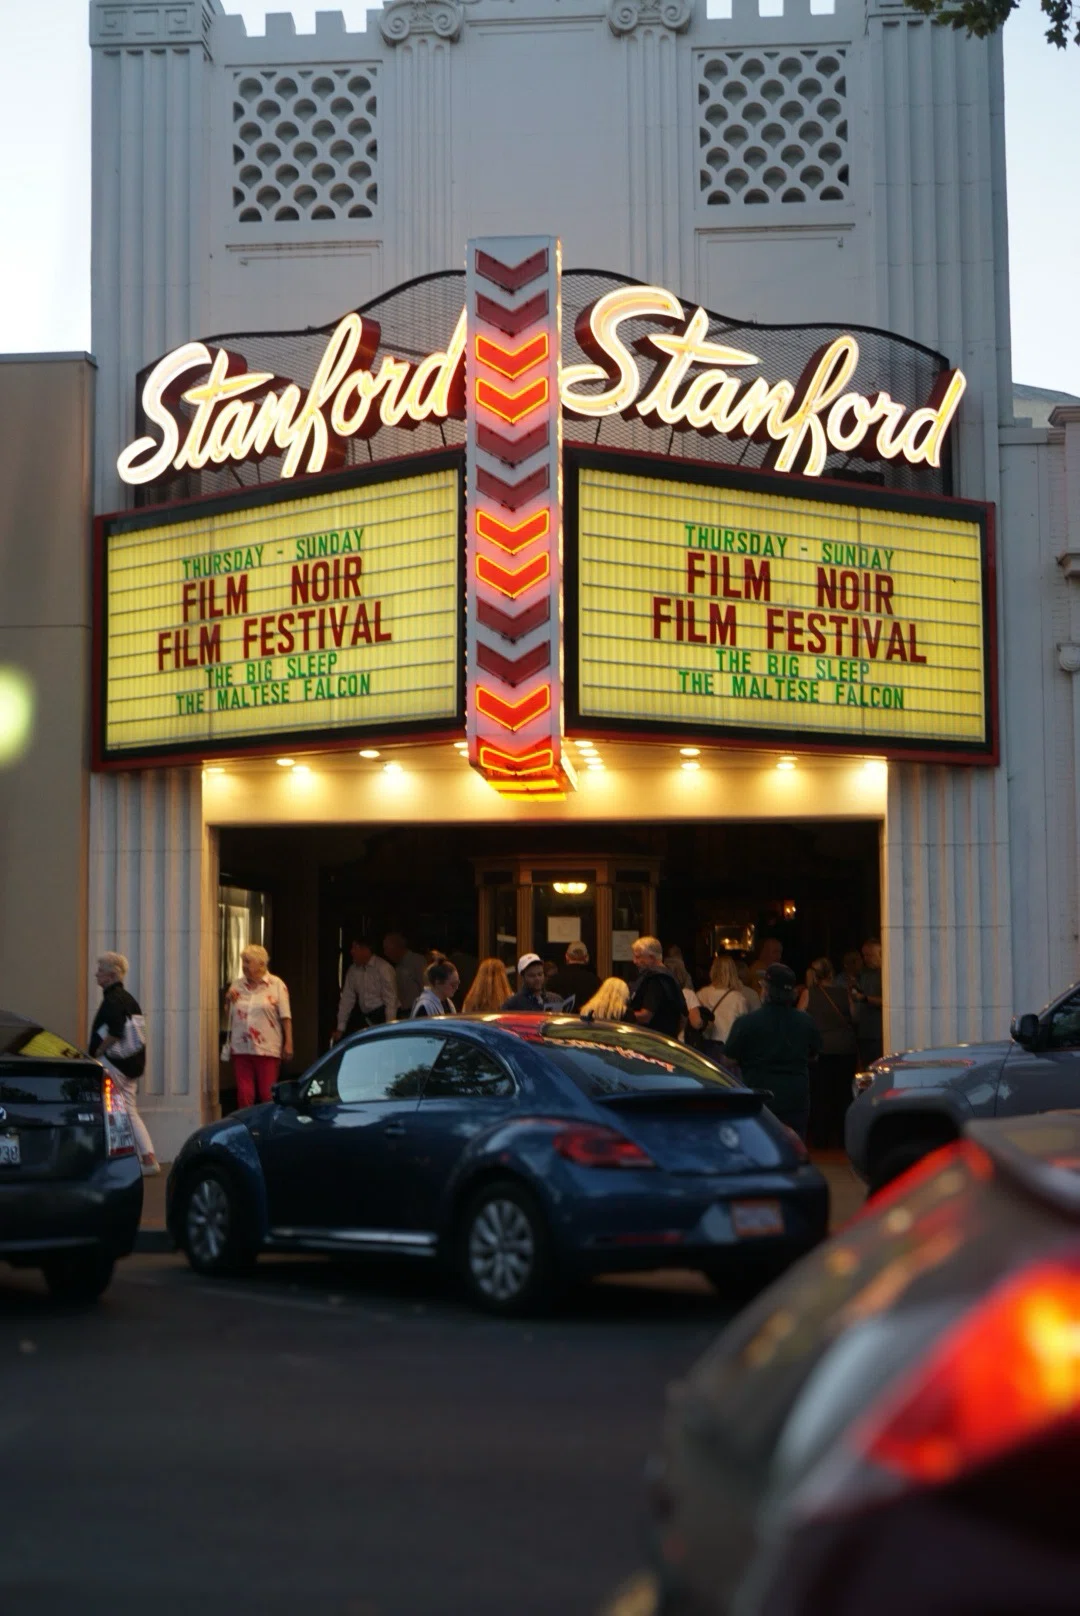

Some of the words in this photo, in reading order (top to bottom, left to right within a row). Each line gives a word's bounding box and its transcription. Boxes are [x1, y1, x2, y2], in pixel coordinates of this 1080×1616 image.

[117, 312, 468, 484] Stanford
[561, 285, 967, 477] Stanford
[182, 546, 264, 579] THURSDAY
[296, 528, 365, 560] SUNDAY
[684, 525, 787, 557] THURSDAY
[821, 541, 894, 571] SUNDAY
[183, 574, 248, 622] FILM
[291, 556, 362, 604] NOIR
[687, 552, 771, 602] FILM
[817, 567, 894, 615] NOIR
[158, 624, 221, 670] FILM
[243, 601, 392, 659] FESTIVAL
[653, 597, 736, 646] FILM
[766, 608, 927, 663] FESTIVAL
[176, 692, 204, 715] THE
[216, 683, 290, 710] MALTESE
[304, 673, 371, 700] FALCON
[205, 666, 233, 689] THE
[246, 661, 273, 684] BIG
[287, 652, 338, 679] SLEEP
[679, 671, 714, 695] THE
[732, 676, 819, 703] MALTESE
[835, 683, 904, 709] FALCON
[716, 650, 751, 673] THE
[767, 655, 800, 676] BIG
[816, 659, 870, 683] SLEEP
